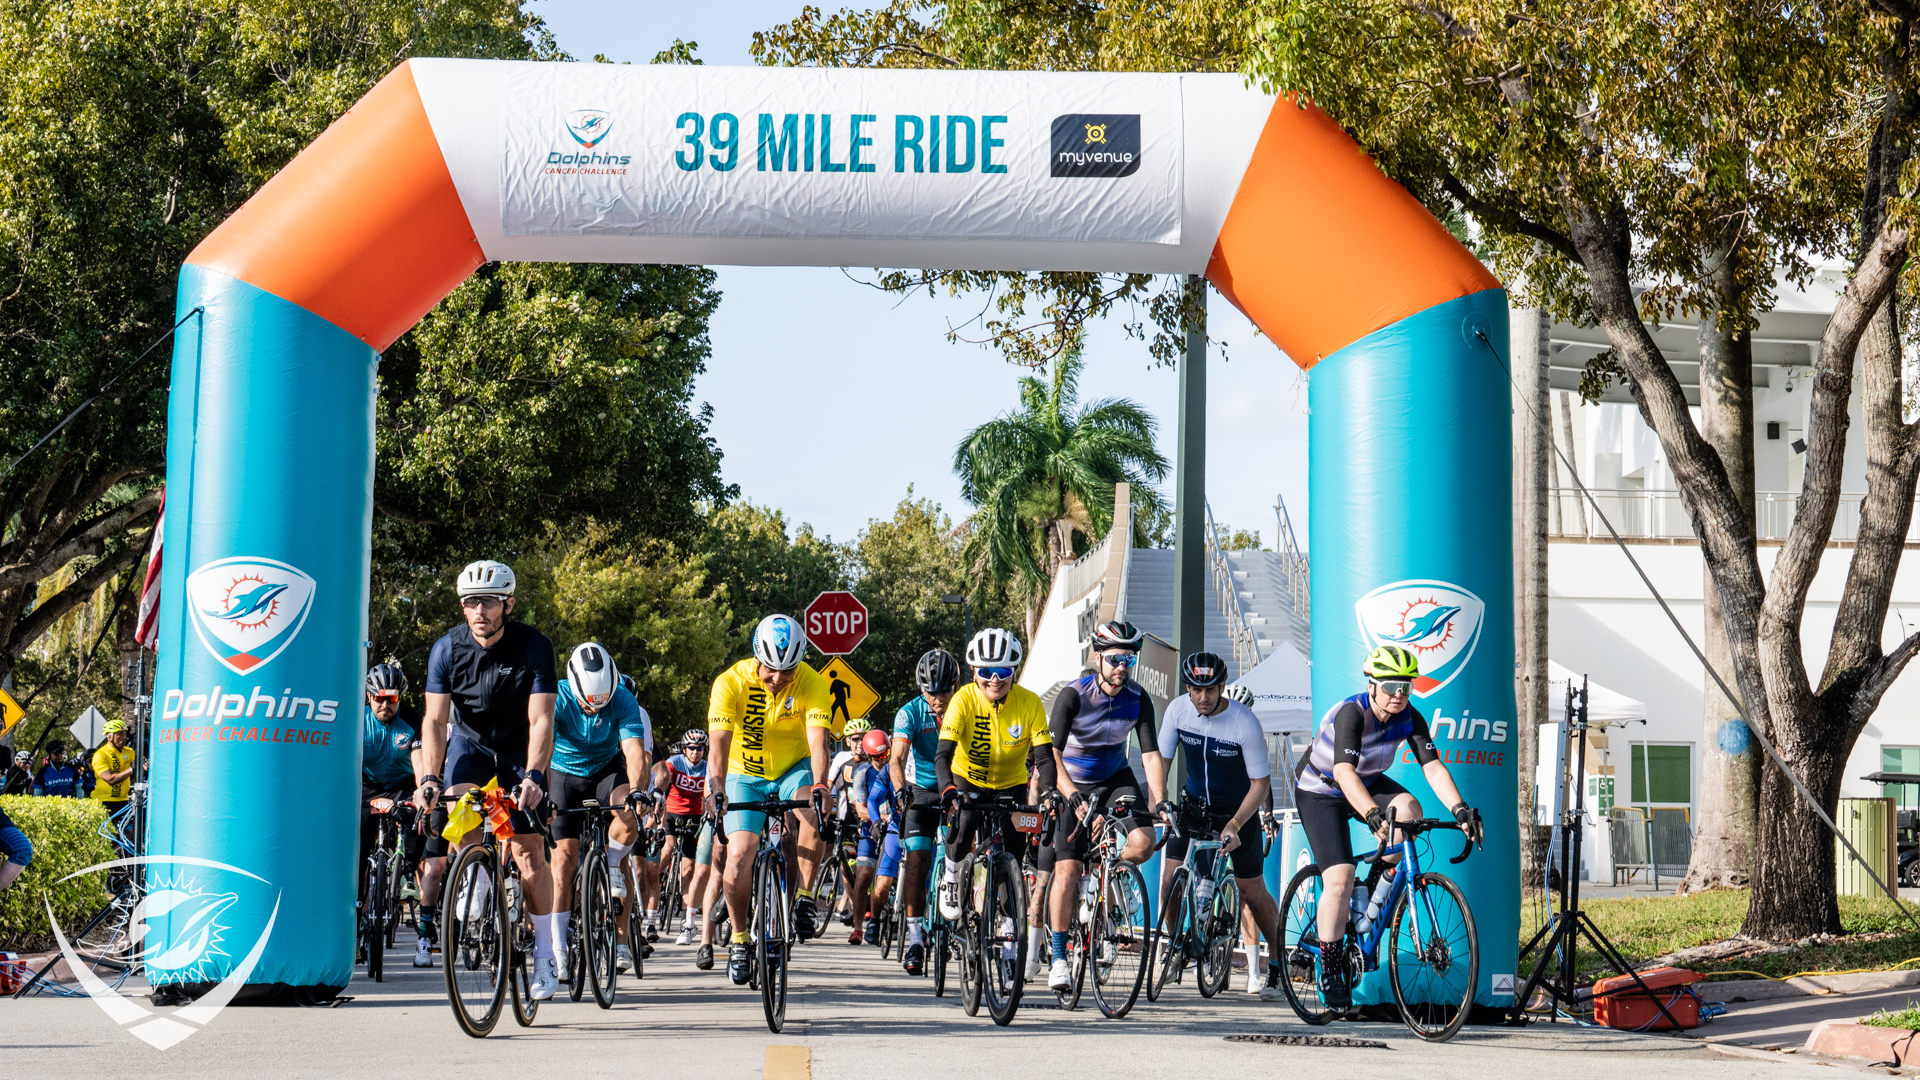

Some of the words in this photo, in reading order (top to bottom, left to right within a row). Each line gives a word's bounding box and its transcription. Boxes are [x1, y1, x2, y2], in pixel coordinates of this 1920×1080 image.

[675, 111, 740, 172] 39
[757, 113, 876, 173] MILE
[894, 114, 1008, 174] RIDE
[547, 151, 632, 168] Dolphins
[1059, 152, 1132, 166] myvenue
[544, 167, 577, 175] CANCER
[809, 611, 864, 635] STOP
[1139, 664, 1169, 700] CORRAL
[162, 685, 341, 726] Dolphins
[1429, 708, 1508, 744] hins
[159, 727, 214, 744] CANCER
[218, 727, 332, 746] CHALLENGE
[742, 752, 765, 778] IDE
[1402, 750, 1504, 766] CLLENGE
[44, 777, 74, 786] LENNAR
[1020, 815, 1038, 828] 969
